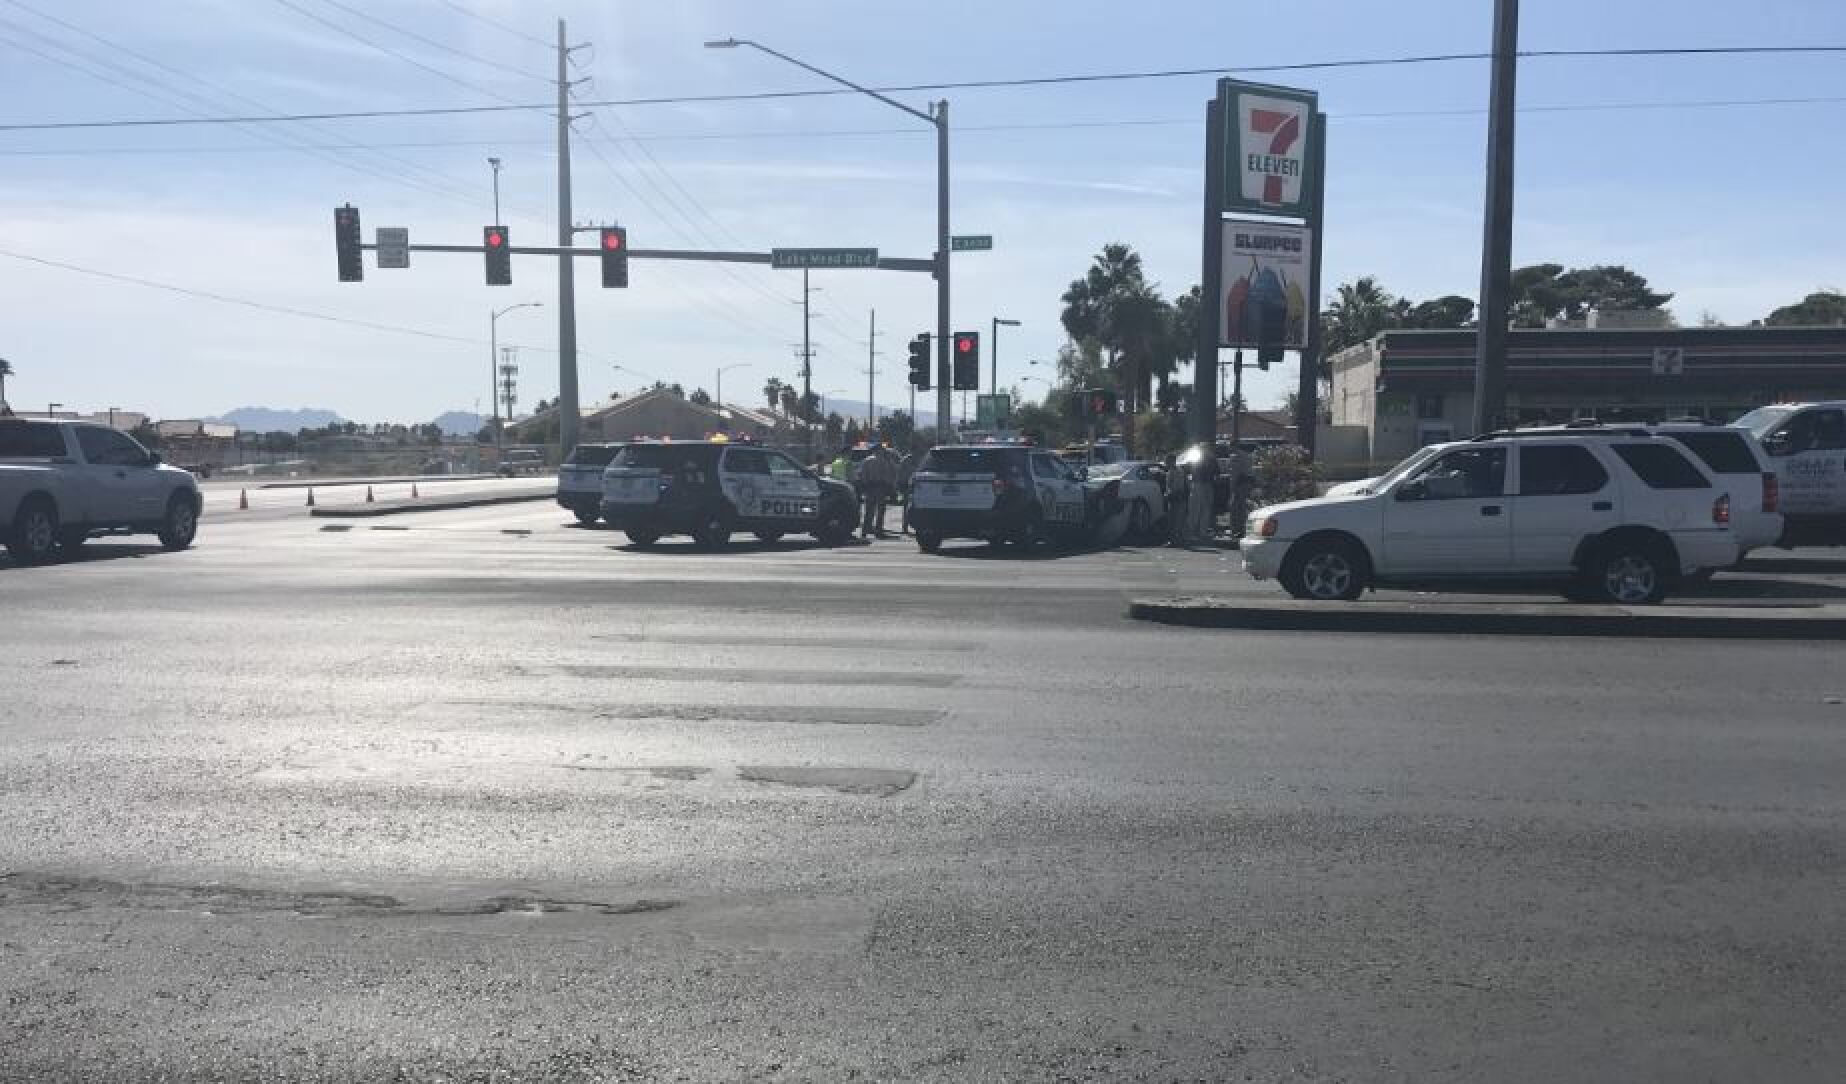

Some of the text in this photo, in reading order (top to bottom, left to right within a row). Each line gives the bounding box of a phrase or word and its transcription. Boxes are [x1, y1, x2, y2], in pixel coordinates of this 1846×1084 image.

[1252, 110, 1299, 202] 7
[780, 253, 872, 267] Lake Mead Blvd
